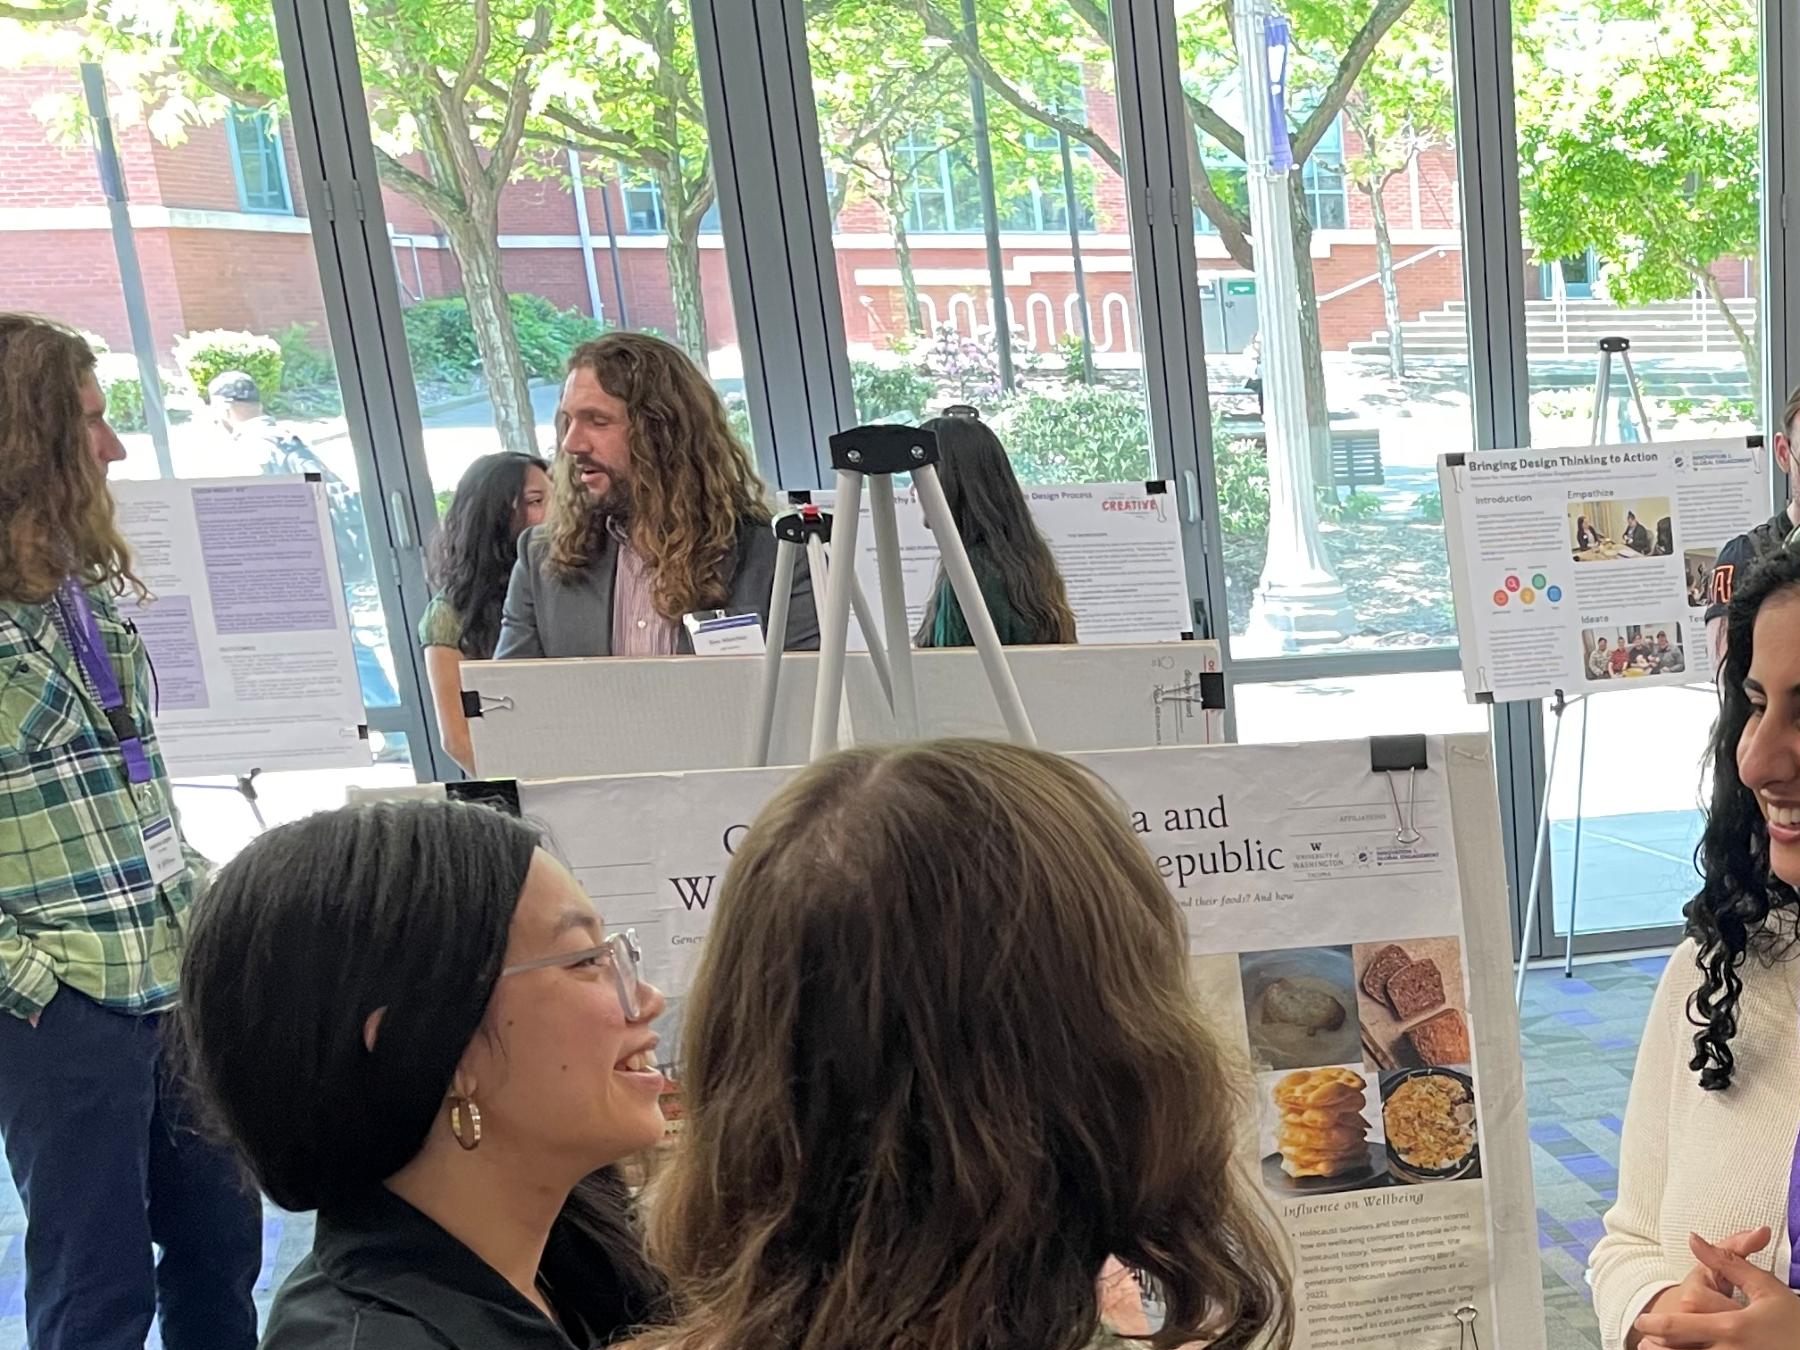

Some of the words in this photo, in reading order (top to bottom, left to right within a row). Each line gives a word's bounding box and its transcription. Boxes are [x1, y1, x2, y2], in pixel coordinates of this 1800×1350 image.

[1469, 460, 1517, 473] Bringing
[1520, 458, 1557, 469] Design
[1560, 455, 1607, 467] Thinking
[1624, 453, 1658, 463] Action
[1032, 492, 1058, 501] Design
[1476, 494, 1532, 504] Introduction
[1568, 489, 1613, 499] Empathize
[1581, 615, 1609, 624] Ideate
[1165, 794, 1229, 831] and
[1157, 837, 1285, 888] epublic
[1254, 892, 1272, 902] And
[1275, 892, 1294, 901] how
[1284, 1201, 1339, 1218] Influence
[1364, 1191, 1423, 1210] Wellbeing
[1307, 1302, 1345, 1312] Childhood
